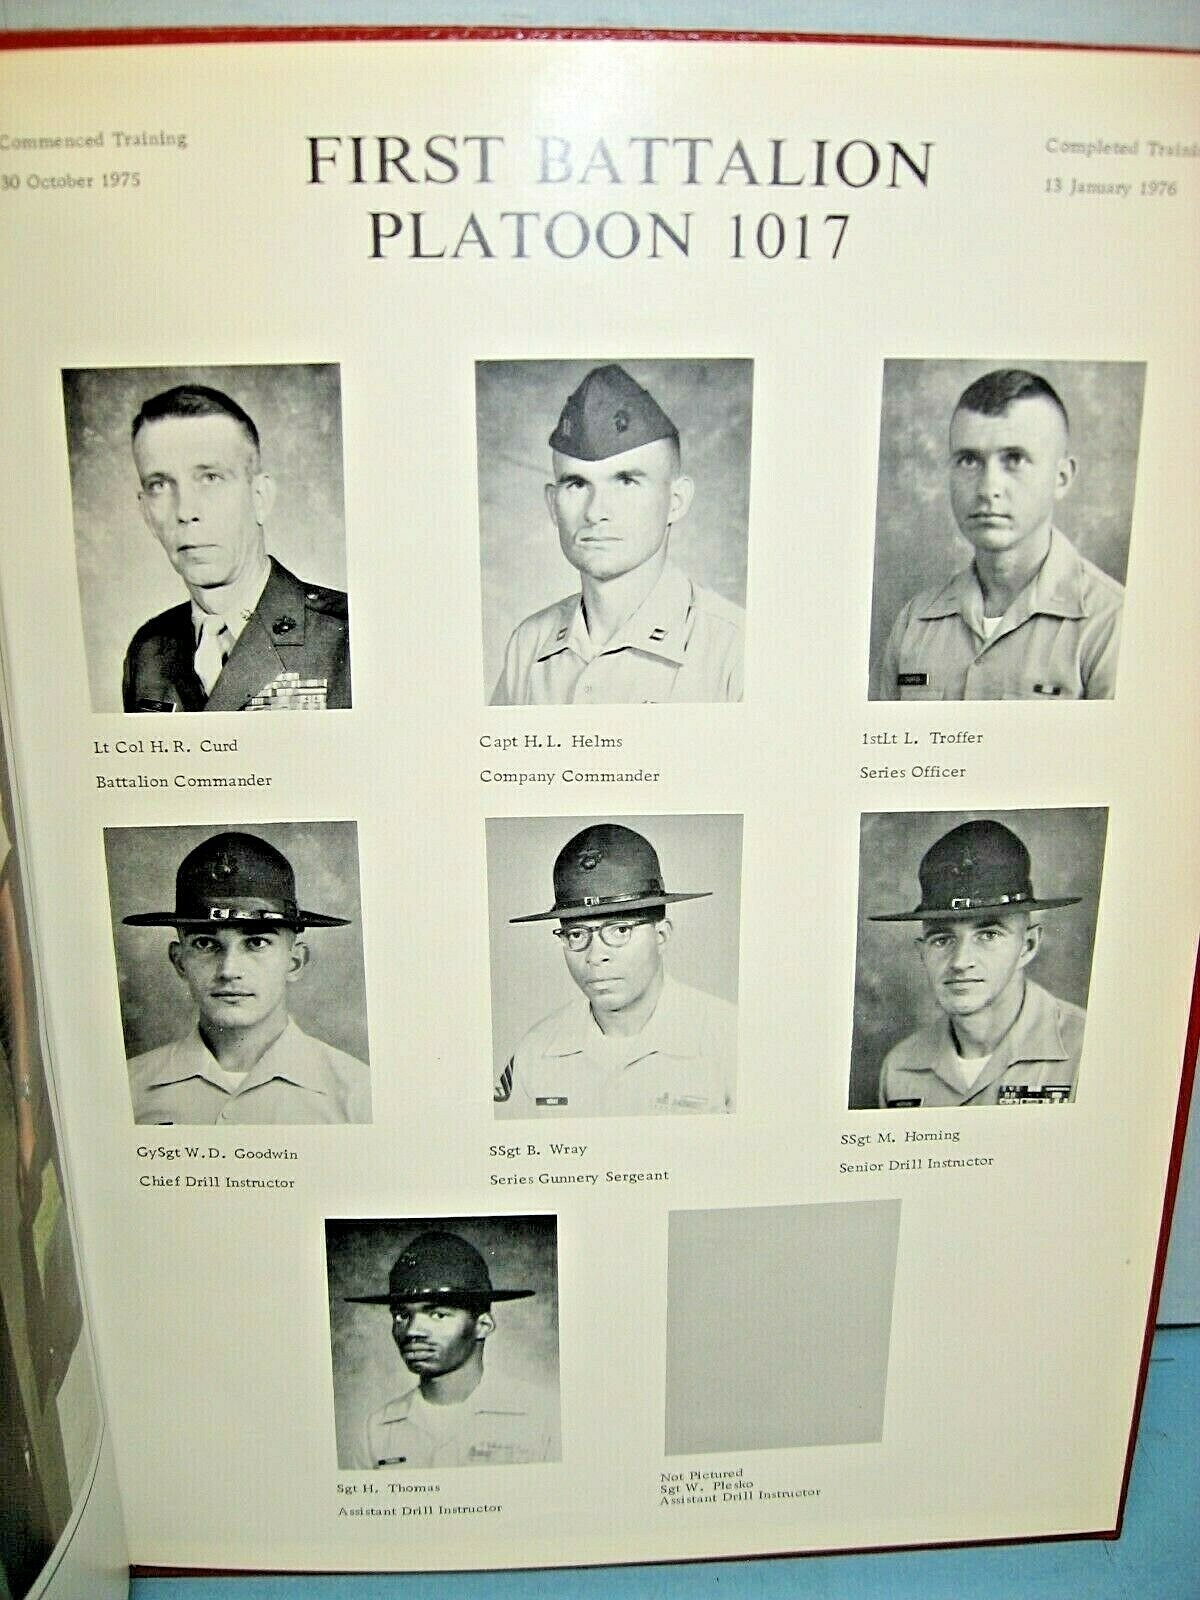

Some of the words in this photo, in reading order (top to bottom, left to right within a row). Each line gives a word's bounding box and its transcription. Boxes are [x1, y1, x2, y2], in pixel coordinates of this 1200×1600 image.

[0, 132, 104, 150] Commenced
[111, 130, 188, 150] Training
[1045, 137, 1138, 158] Completed
[1146, 140, 1200, 157] Traini
[305, 134, 505, 185] FIRST
[538, 137, 936, 190] BATTALION
[0, 174, 21, 191] 30
[26, 173, 95, 190] October
[102, 170, 141, 188] 1975
[1045, 177, 1062, 193] 13
[1068, 177, 1132, 198] January
[1140, 179, 1178, 196] 1976
[366, 210, 694, 260] PLATOON
[731, 212, 851, 261] 1017
[479, 736, 519, 751] Capt
[572, 734, 623, 748] Helms
[904, 732, 919, 745] L.
[929, 731, 984, 745] Troffer
[94, 741, 109, 754] Lt
[115, 740, 144, 753] Col
[200, 739, 239, 752] Curd
[479, 769, 556, 786] Company
[561, 769, 661, 783] Commander
[860, 766, 907, 780] Series
[911, 765, 967, 778] Officer
[96, 775, 169, 789] Battalion
[174, 773, 273, 788] Commander
[840, 1134, 872, 1148] SSgt
[877, 1132, 896, 1144] M.
[136, 1146, 181, 1160] GySgt
[234, 1148, 299, 1160] Goodwin
[489, 1145, 521, 1159] SSgt
[527, 1144, 541, 1156] B.
[549, 1143, 588, 1157] Wray
[839, 1162, 884, 1174] Senior
[889, 1159, 922, 1171] Drill
[927, 1156, 995, 1169] Instructor
[139, 1175, 181, 1187] Chief
[186, 1176, 220, 1188] Drill
[225, 1177, 296, 1189] Instructor
[490, 1174, 534, 1186] Series
[538, 1173, 599, 1186] Gunnery
[605, 1170, 670, 1184] Sergeant
[660, 1473, 684, 1483] Not
[690, 1468, 744, 1481] Pictured
[336, 1483, 358, 1495] Sgt
[387, 1483, 441, 1494] Thomas
[660, 1484, 681, 1496] Sgt
[685, 1482, 704, 1493] W.
[713, 1480, 754, 1491] Plesko
[660, 1493, 718, 1506] Assistant
[722, 1491, 753, 1502] Drill
[758, 1488, 822, 1501] Instructor
[338, 1506, 397, 1517] Assistant
[401, 1505, 433, 1516] Drill
[438, 1503, 504, 1516] Instructor
